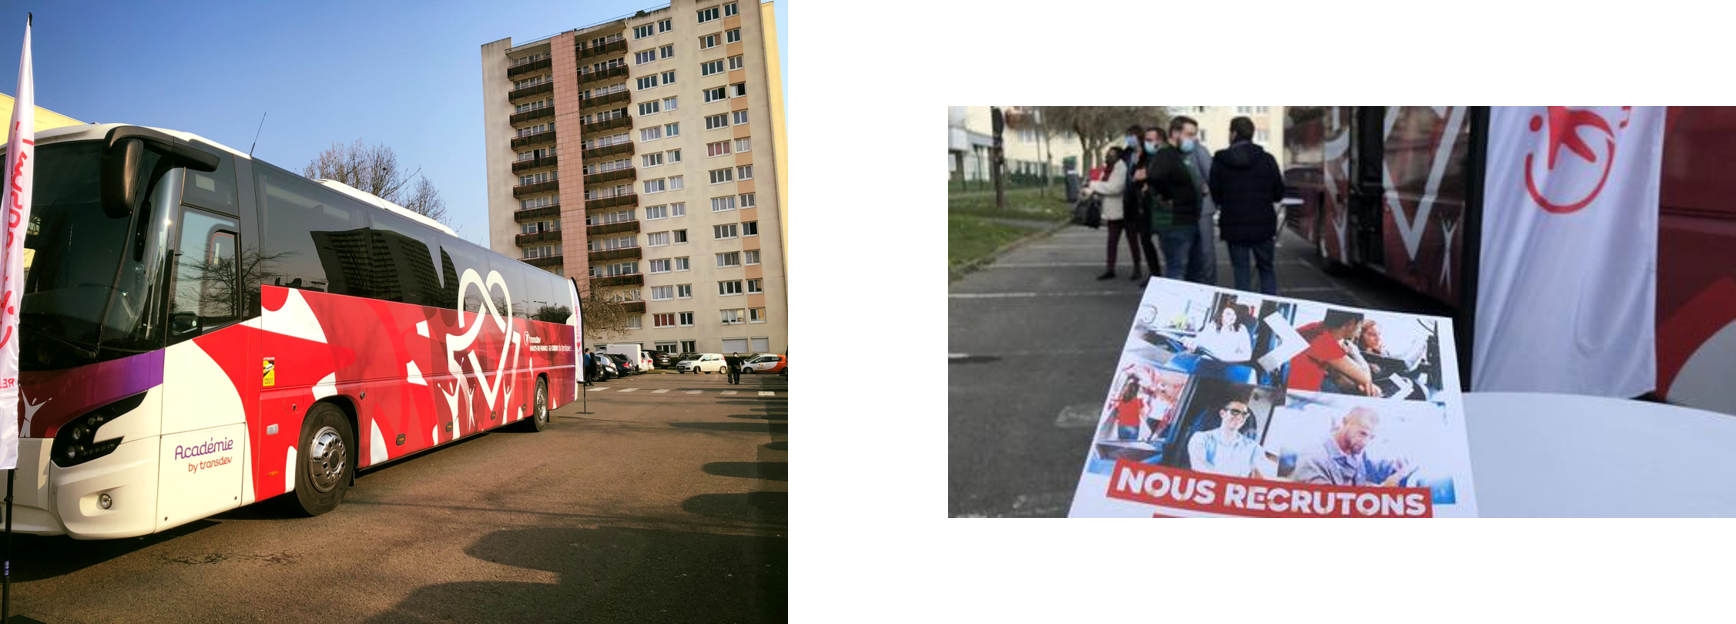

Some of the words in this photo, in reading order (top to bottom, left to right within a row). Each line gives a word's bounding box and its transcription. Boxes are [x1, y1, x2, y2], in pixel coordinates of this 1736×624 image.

[174, 437, 234, 460] Académie
[188, 462, 198, 474] by
[199, 456, 233, 470] transdev
[1116, 466, 1216, 505] NOUS
[1224, 483, 1427, 517] RECRUTONS
